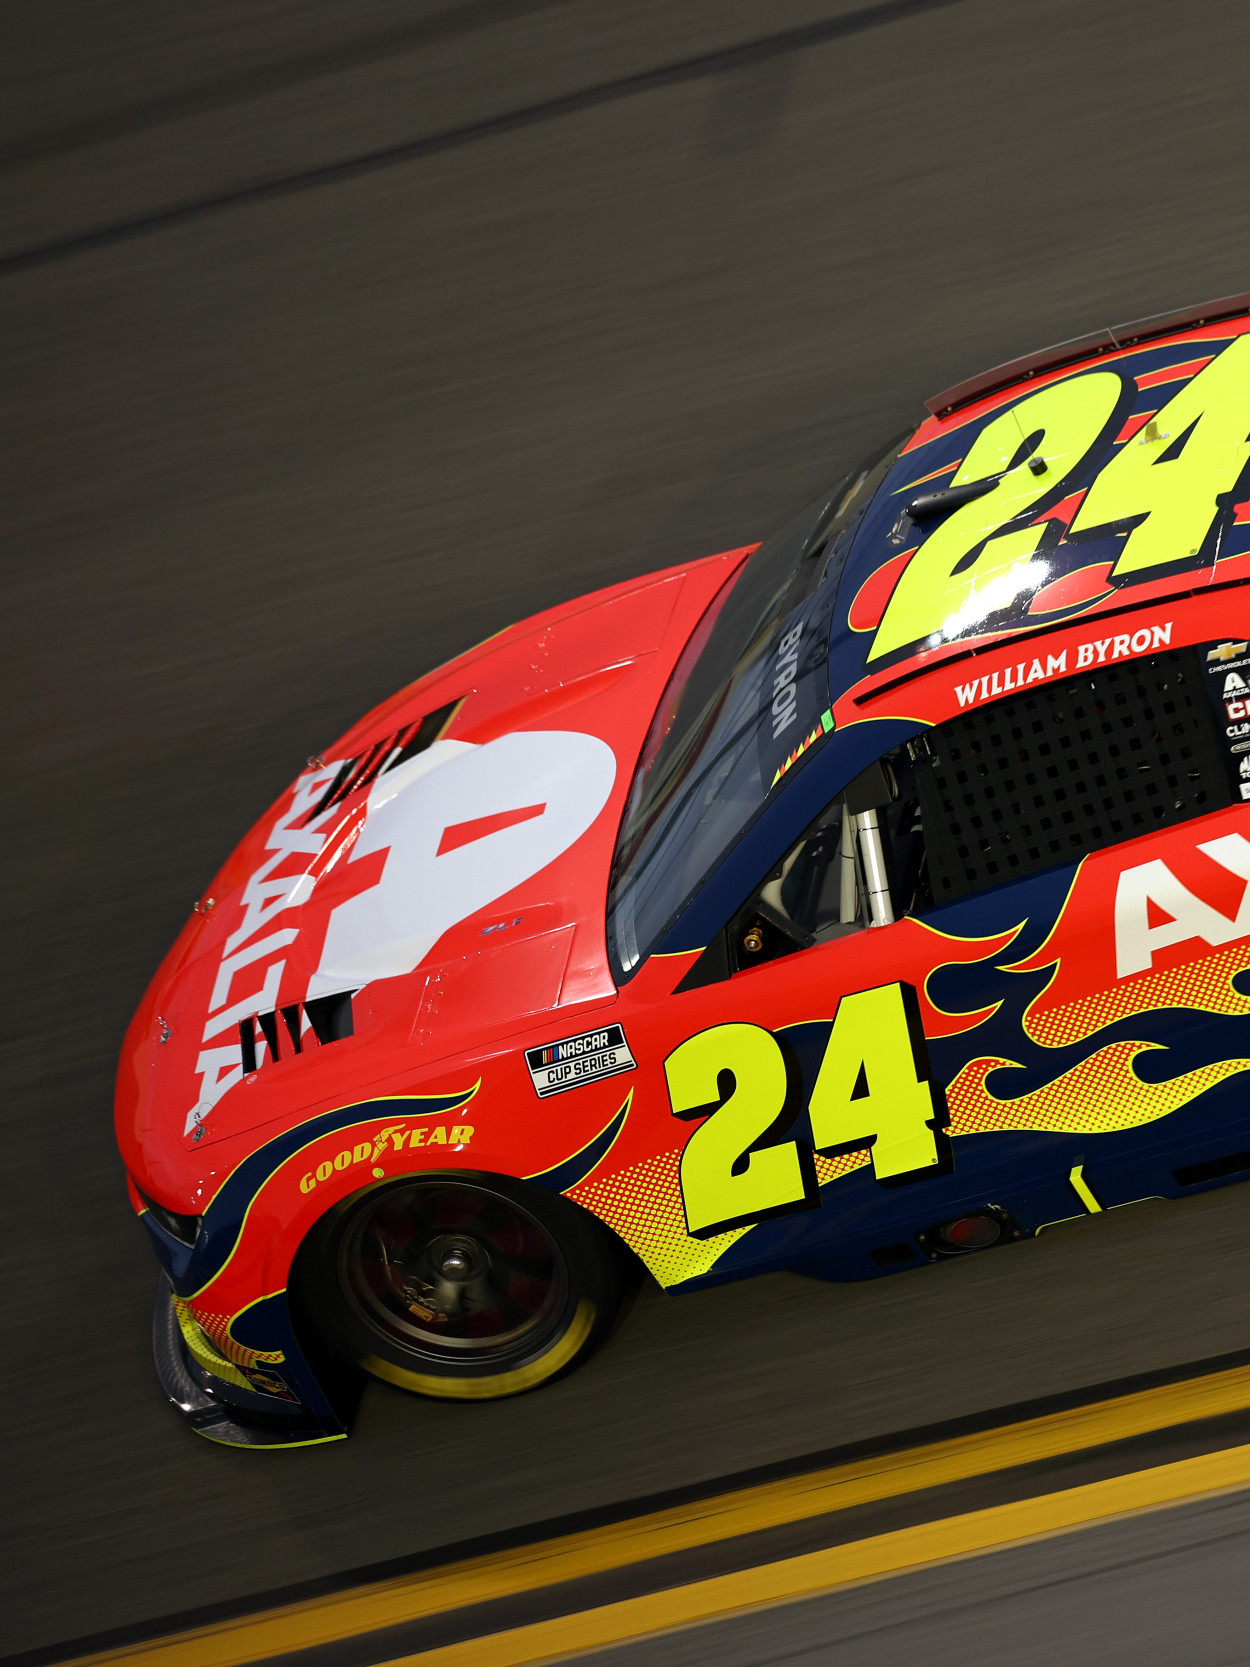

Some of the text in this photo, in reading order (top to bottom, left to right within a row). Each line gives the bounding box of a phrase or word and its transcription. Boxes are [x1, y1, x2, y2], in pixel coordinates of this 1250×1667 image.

[772, 621, 804, 740] BYRON
[954, 622, 1174, 708] WILLIAM BYRON
[547, 1051, 617, 1084] CUP SERIES
[557, 1032, 609, 1060] NASCAR
[663, 980, 944, 1236] 24
